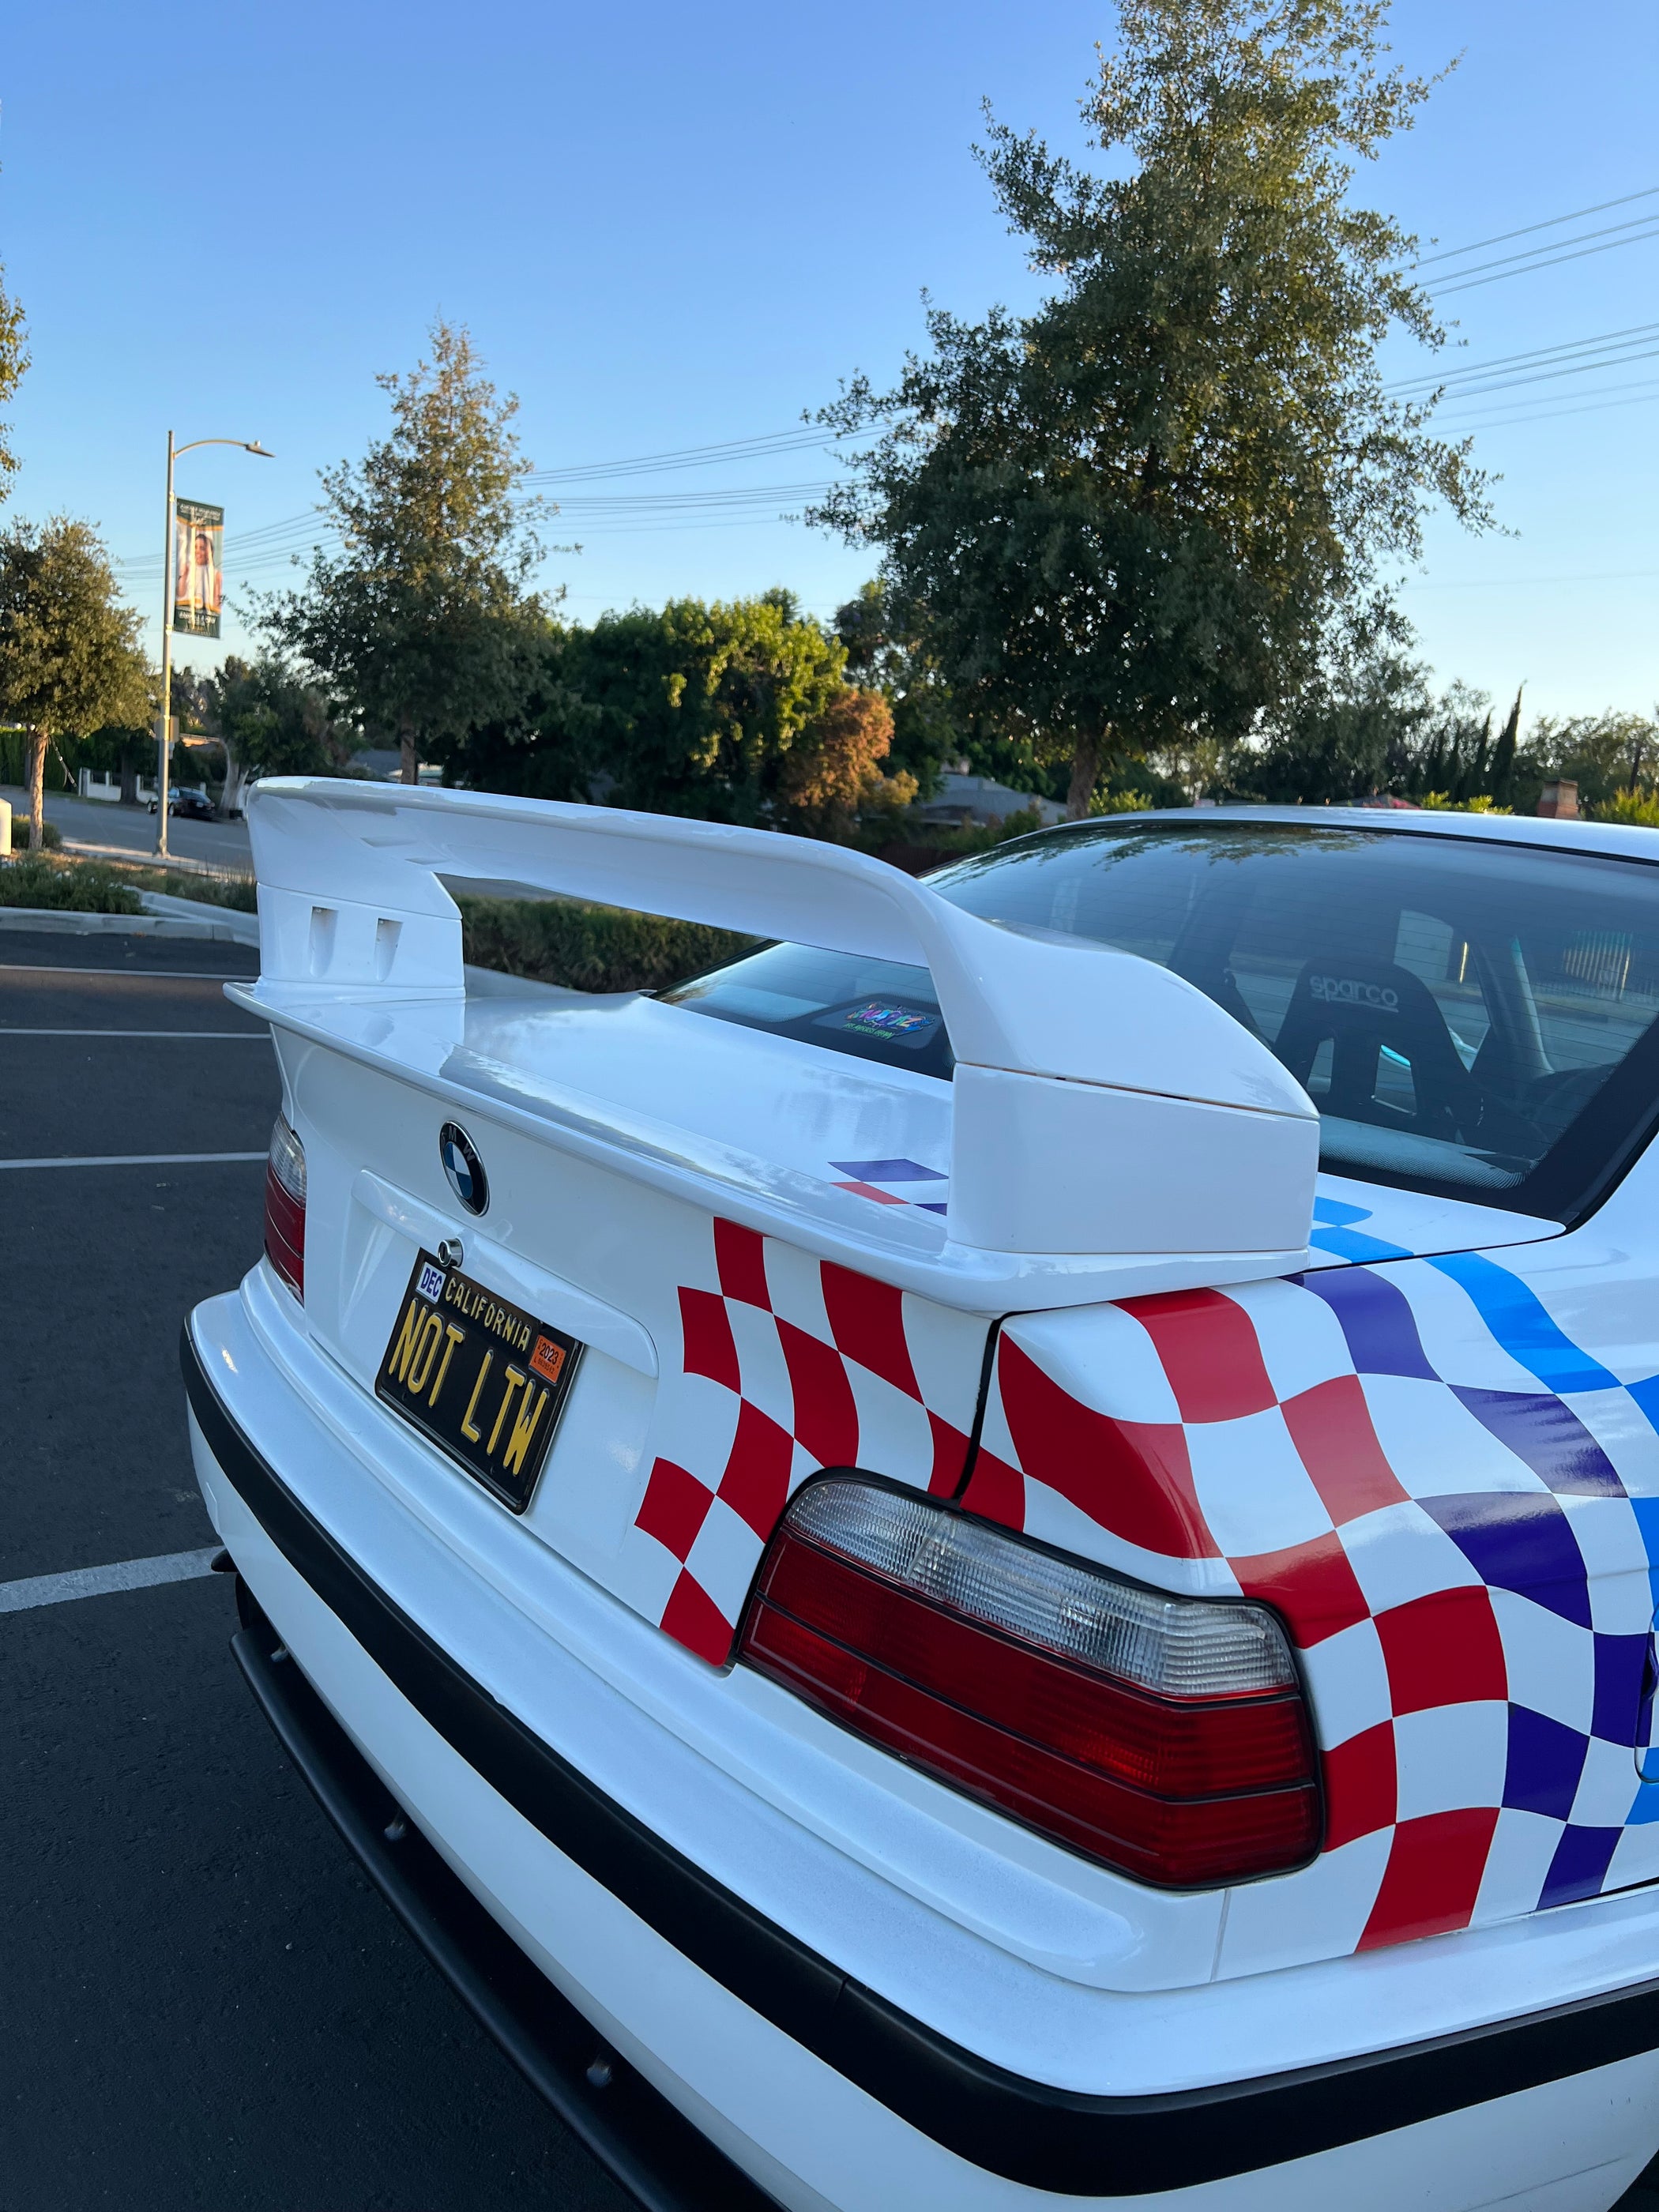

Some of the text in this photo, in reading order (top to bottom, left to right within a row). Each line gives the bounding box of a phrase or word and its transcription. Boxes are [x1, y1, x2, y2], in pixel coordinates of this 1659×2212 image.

[1309, 975, 1399, 1007] sparco
[419, 1267, 444, 1300] DEC
[444, 1276, 532, 1352] CALIFORNIA
[539, 1342, 559, 1365] 2023
[388, 1298, 549, 1477] NOT LTW
